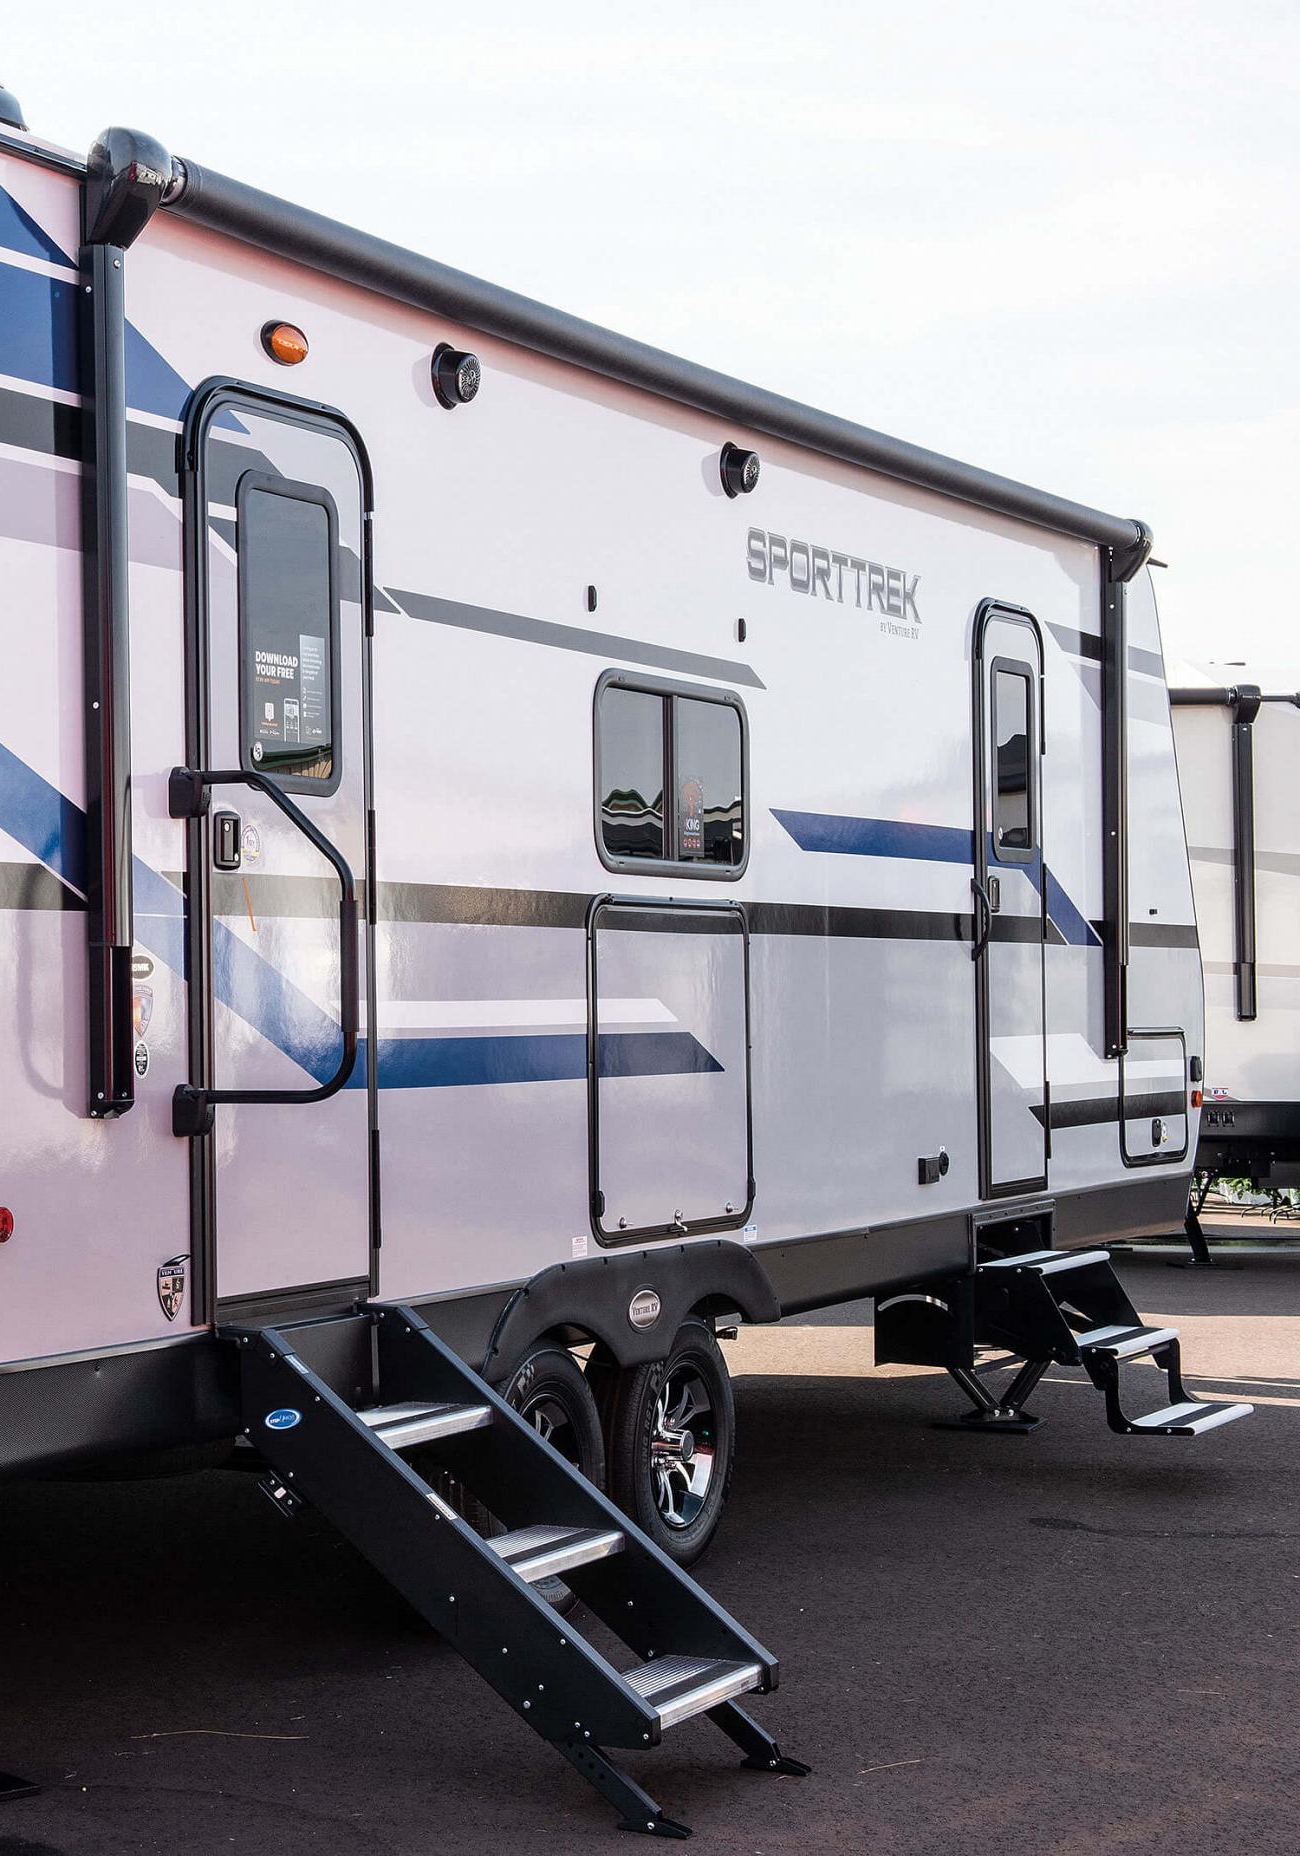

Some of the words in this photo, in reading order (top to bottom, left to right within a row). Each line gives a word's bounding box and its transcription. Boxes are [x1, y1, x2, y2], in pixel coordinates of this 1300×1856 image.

[746, 526, 922, 624] SPORTTREK
[255, 650, 299, 668] DOWNLOAD
[255, 663, 277, 677] YOUR
[277, 667, 295, 680] FREE
[685, 818, 700, 831] KING
